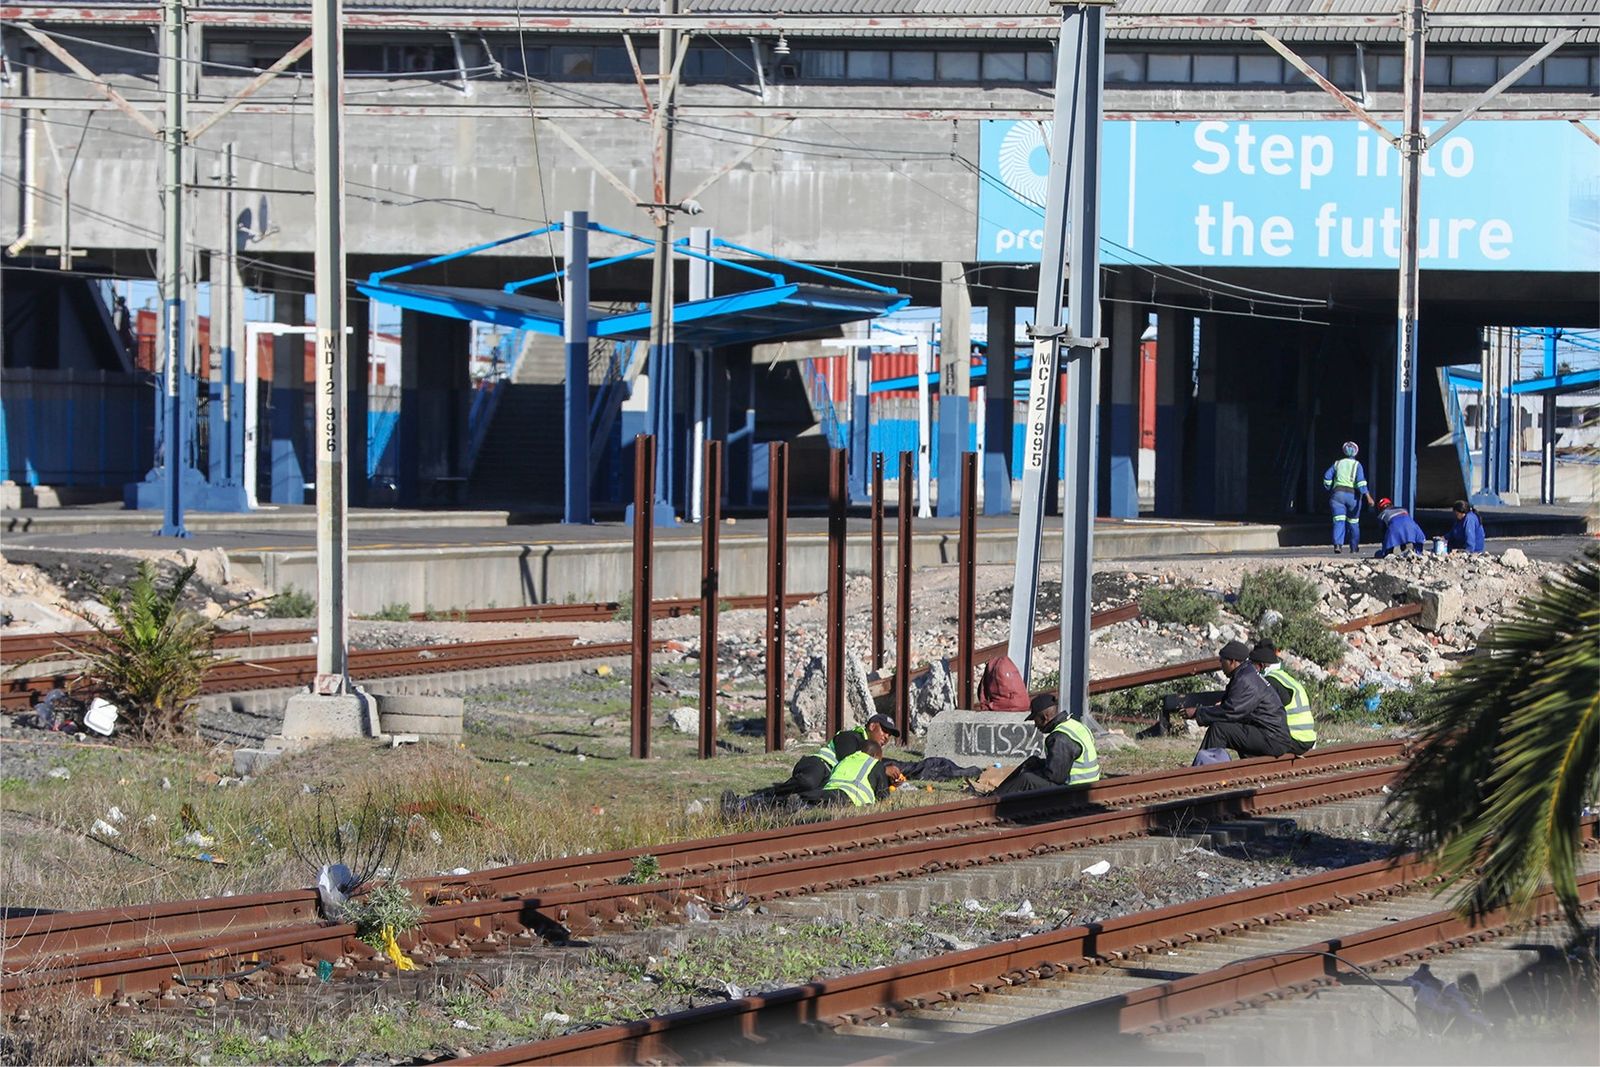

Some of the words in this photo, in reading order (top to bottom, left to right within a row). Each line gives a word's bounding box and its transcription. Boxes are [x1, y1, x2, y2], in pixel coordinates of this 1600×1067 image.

[1192, 120, 1334, 189] Step
[1355, 121, 1475, 178] into
[1195, 201, 1294, 257] the
[1315, 202, 1514, 260] future
